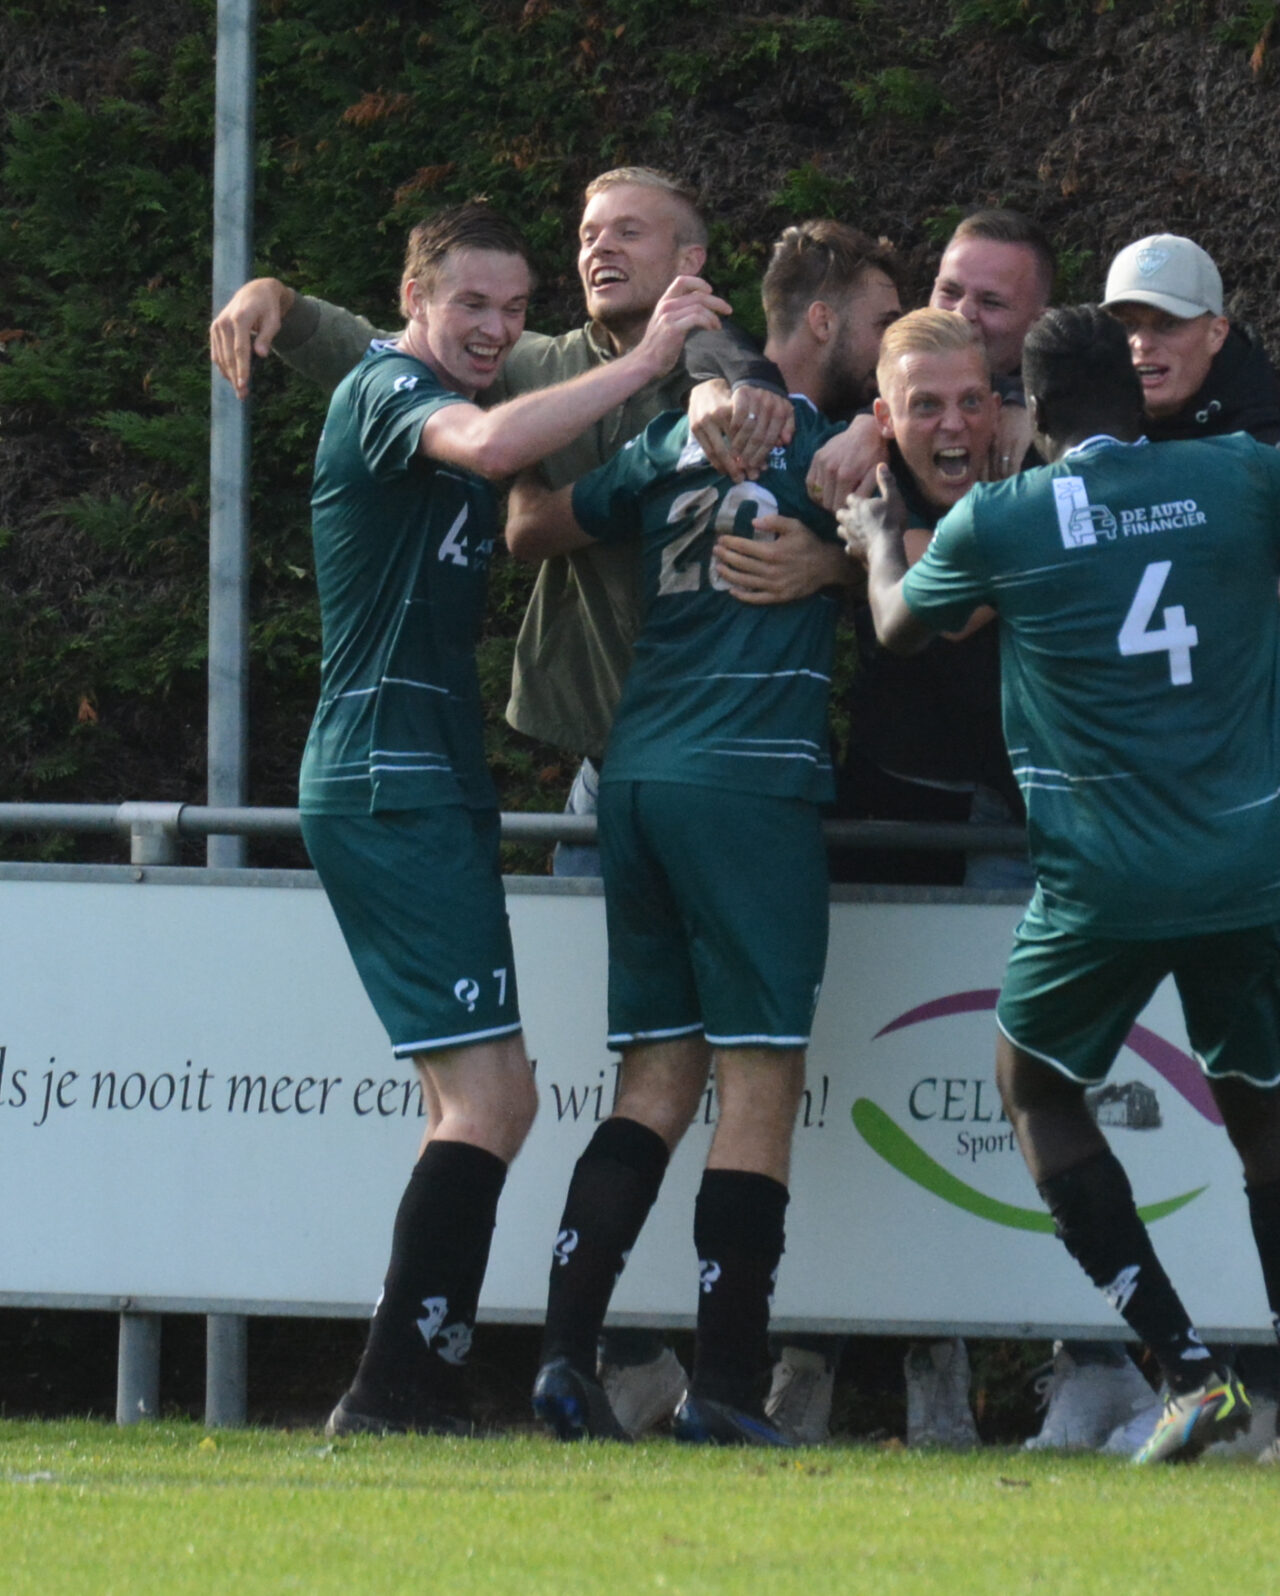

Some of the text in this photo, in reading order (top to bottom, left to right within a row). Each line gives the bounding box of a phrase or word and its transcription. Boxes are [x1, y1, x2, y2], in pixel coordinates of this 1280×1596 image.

[658, 480, 779, 596] 20
[1119, 499, 1198, 524] DE AUTO
[1122, 511, 1206, 537] FINANCIER
[1117, 560, 1198, 685] 4
[33, 1057, 79, 1126] je
[92, 1060, 215, 1112] nooit
[227, 1074, 342, 1115] meer
